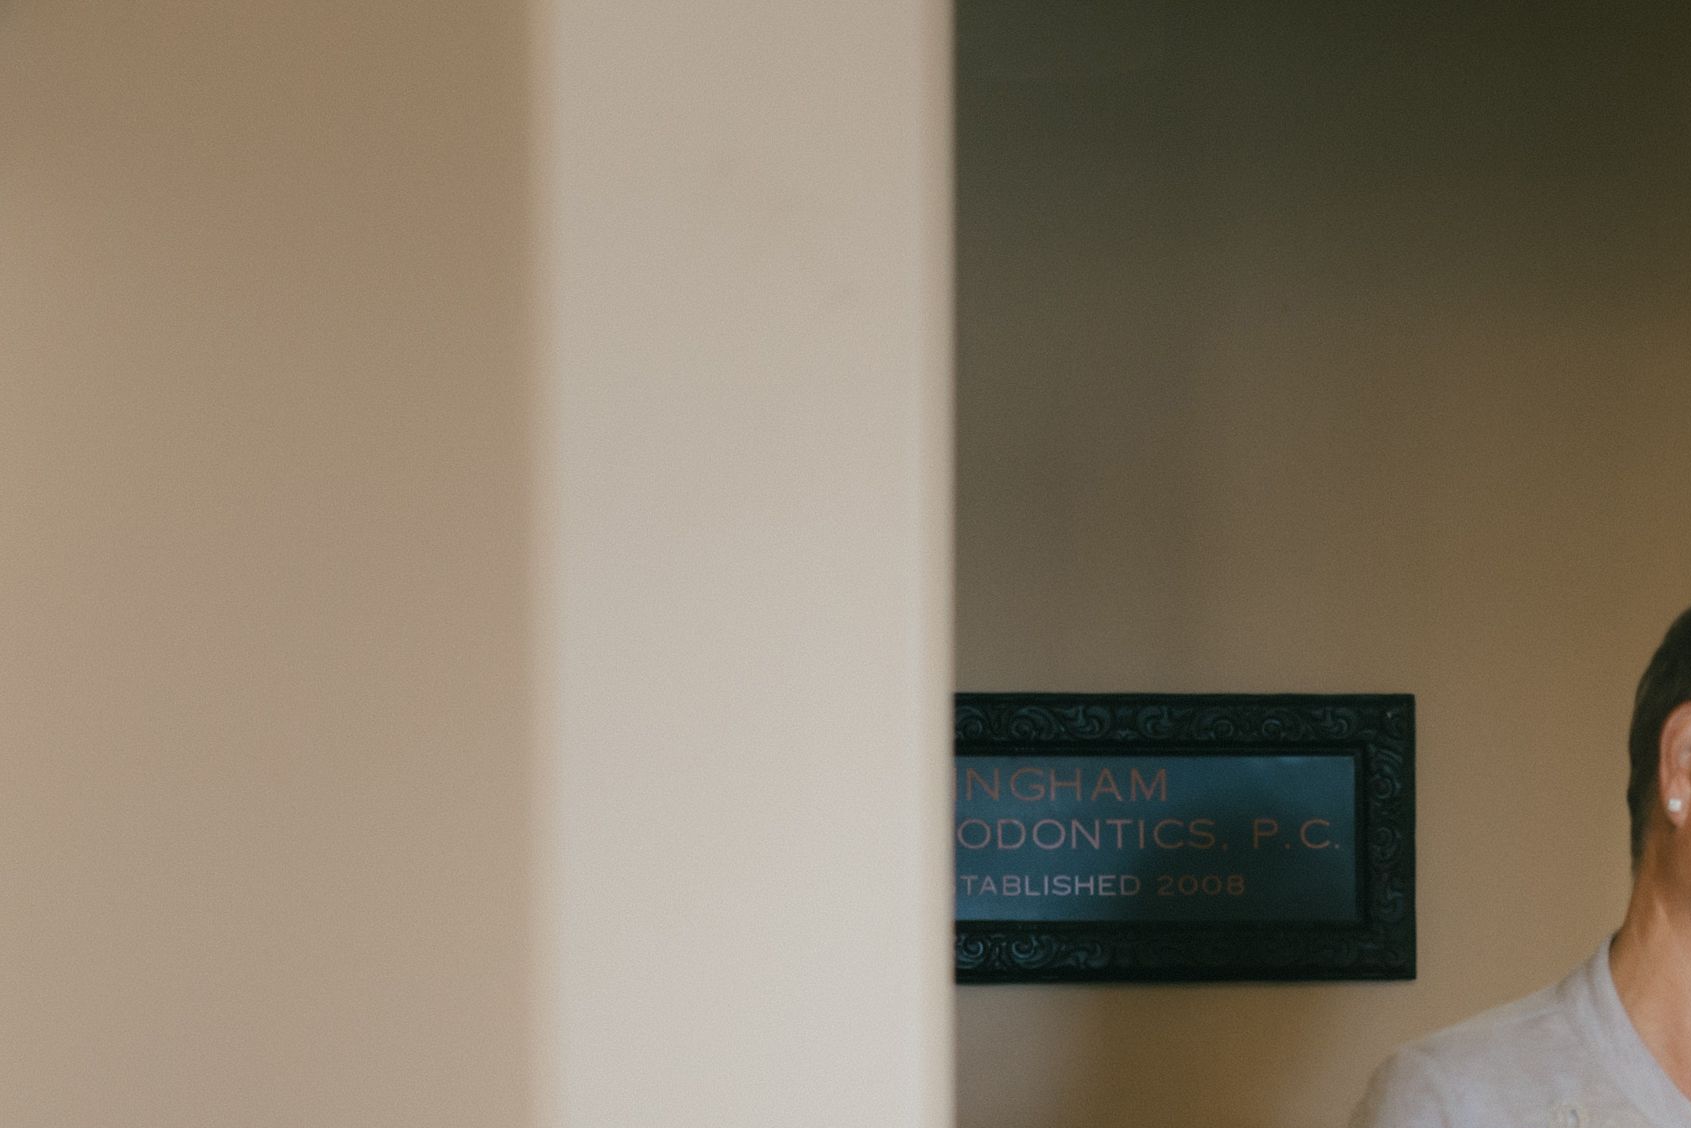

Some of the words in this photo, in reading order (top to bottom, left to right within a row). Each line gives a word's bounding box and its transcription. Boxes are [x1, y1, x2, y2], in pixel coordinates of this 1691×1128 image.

[1251, 817, 1341, 850] P.C.
[959, 874, 1141, 897] TABLISHED
[1156, 873, 1247, 897] 2008
